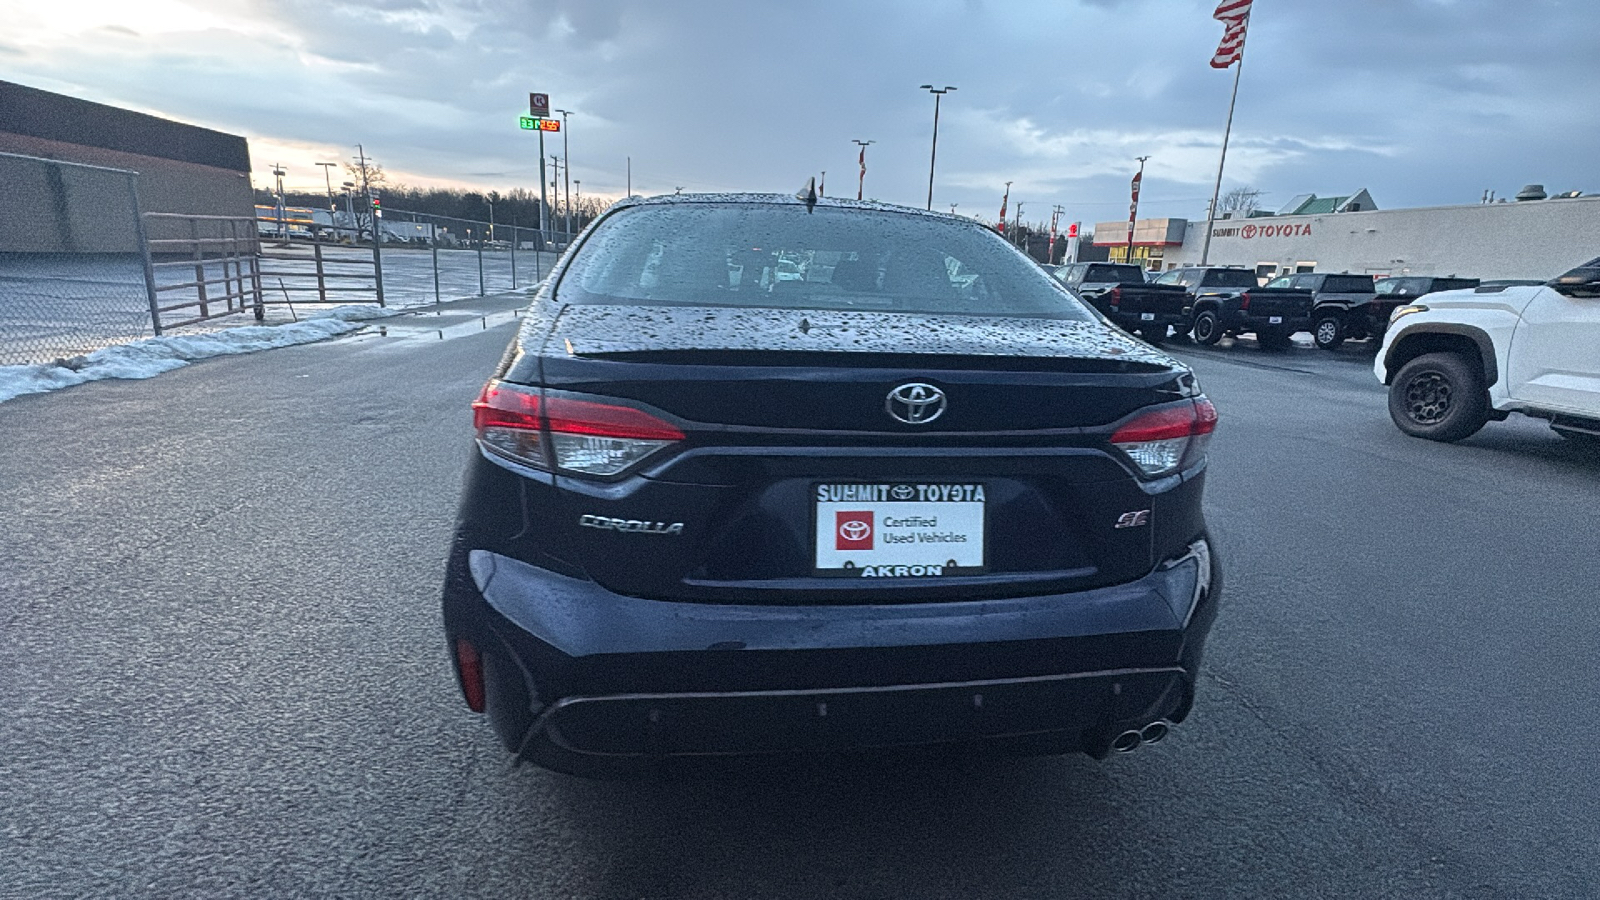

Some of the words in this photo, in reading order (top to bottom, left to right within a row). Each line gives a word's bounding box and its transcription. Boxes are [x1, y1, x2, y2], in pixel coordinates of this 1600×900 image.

[1213, 228, 1240, 237] SUMMIT
[1259, 224, 1311, 237] TOYOTA
[818, 485, 890, 502] SUMMIT
[917, 484, 985, 501] TOYOTA
[580, 514, 684, 535] COROLLA
[883, 516, 937, 528] Certified
[1114, 510, 1150, 528] SE
[883, 532, 916, 544] Used
[918, 532, 967, 544] Vehicles
[861, 566, 942, 577] AKRON
